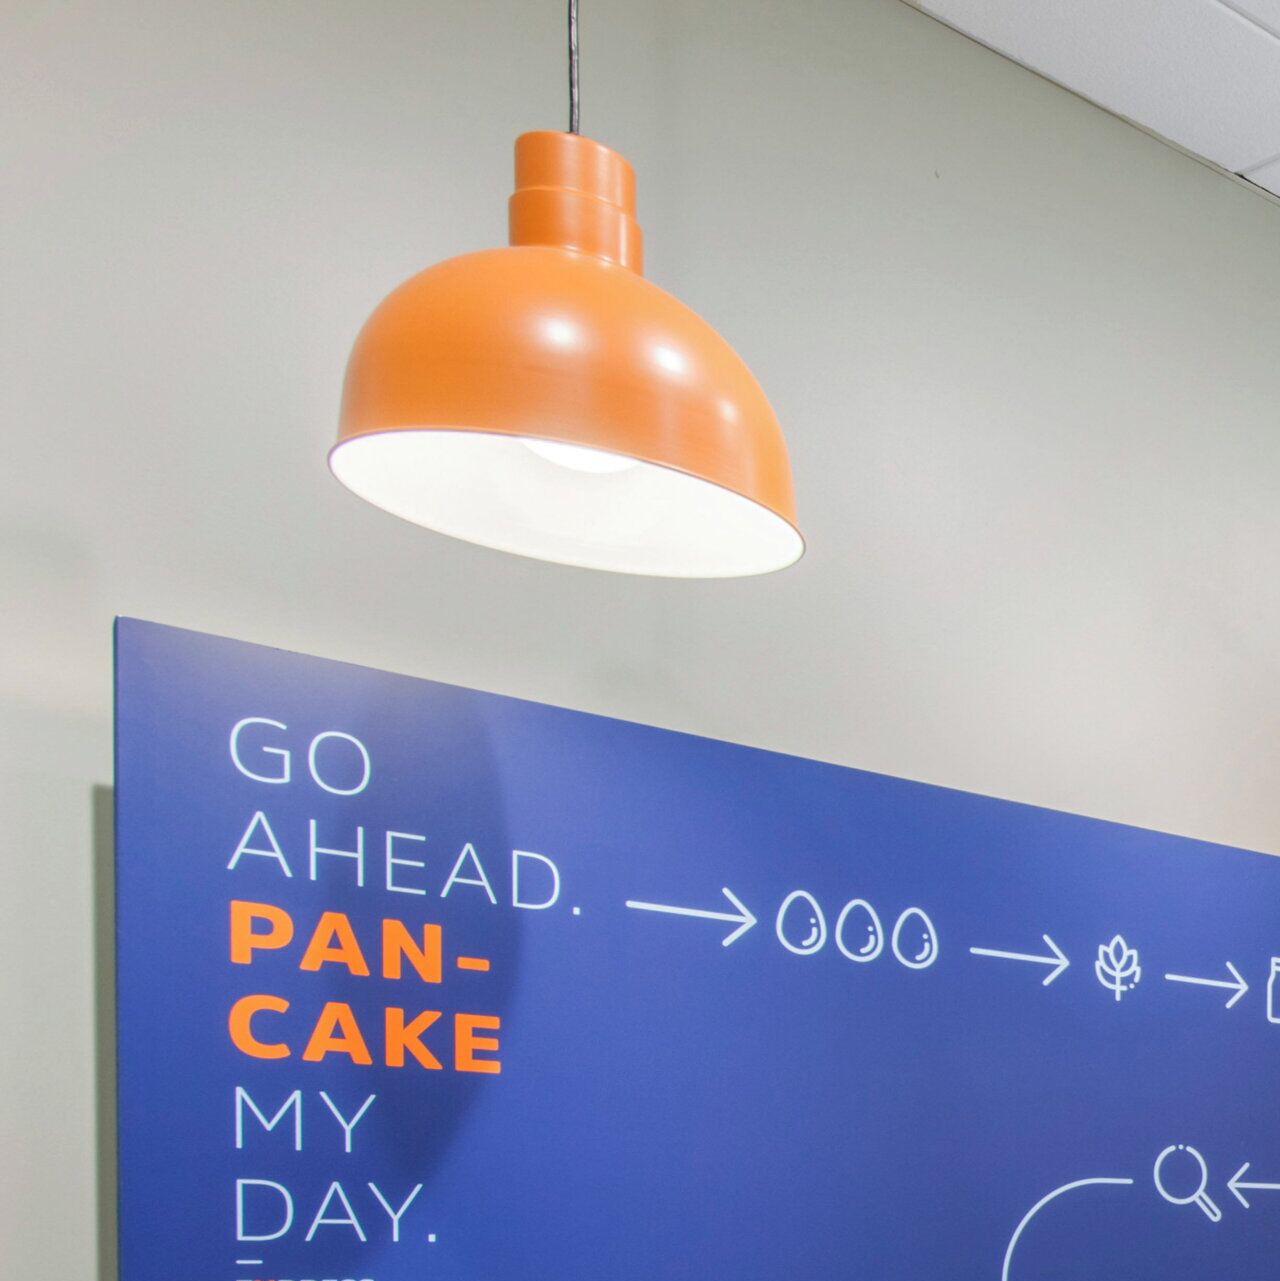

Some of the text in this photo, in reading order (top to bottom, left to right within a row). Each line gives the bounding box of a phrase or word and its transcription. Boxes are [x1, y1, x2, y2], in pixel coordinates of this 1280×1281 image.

[227, 716, 372, 796] GO
[226, 810, 582, 916] AHEAD.
[229, 900, 491, 984] PAN-
[227, 994, 501, 1075] CAKE
[234, 1086, 376, 1154] MY
[234, 1178, 437, 1243] DAY.
